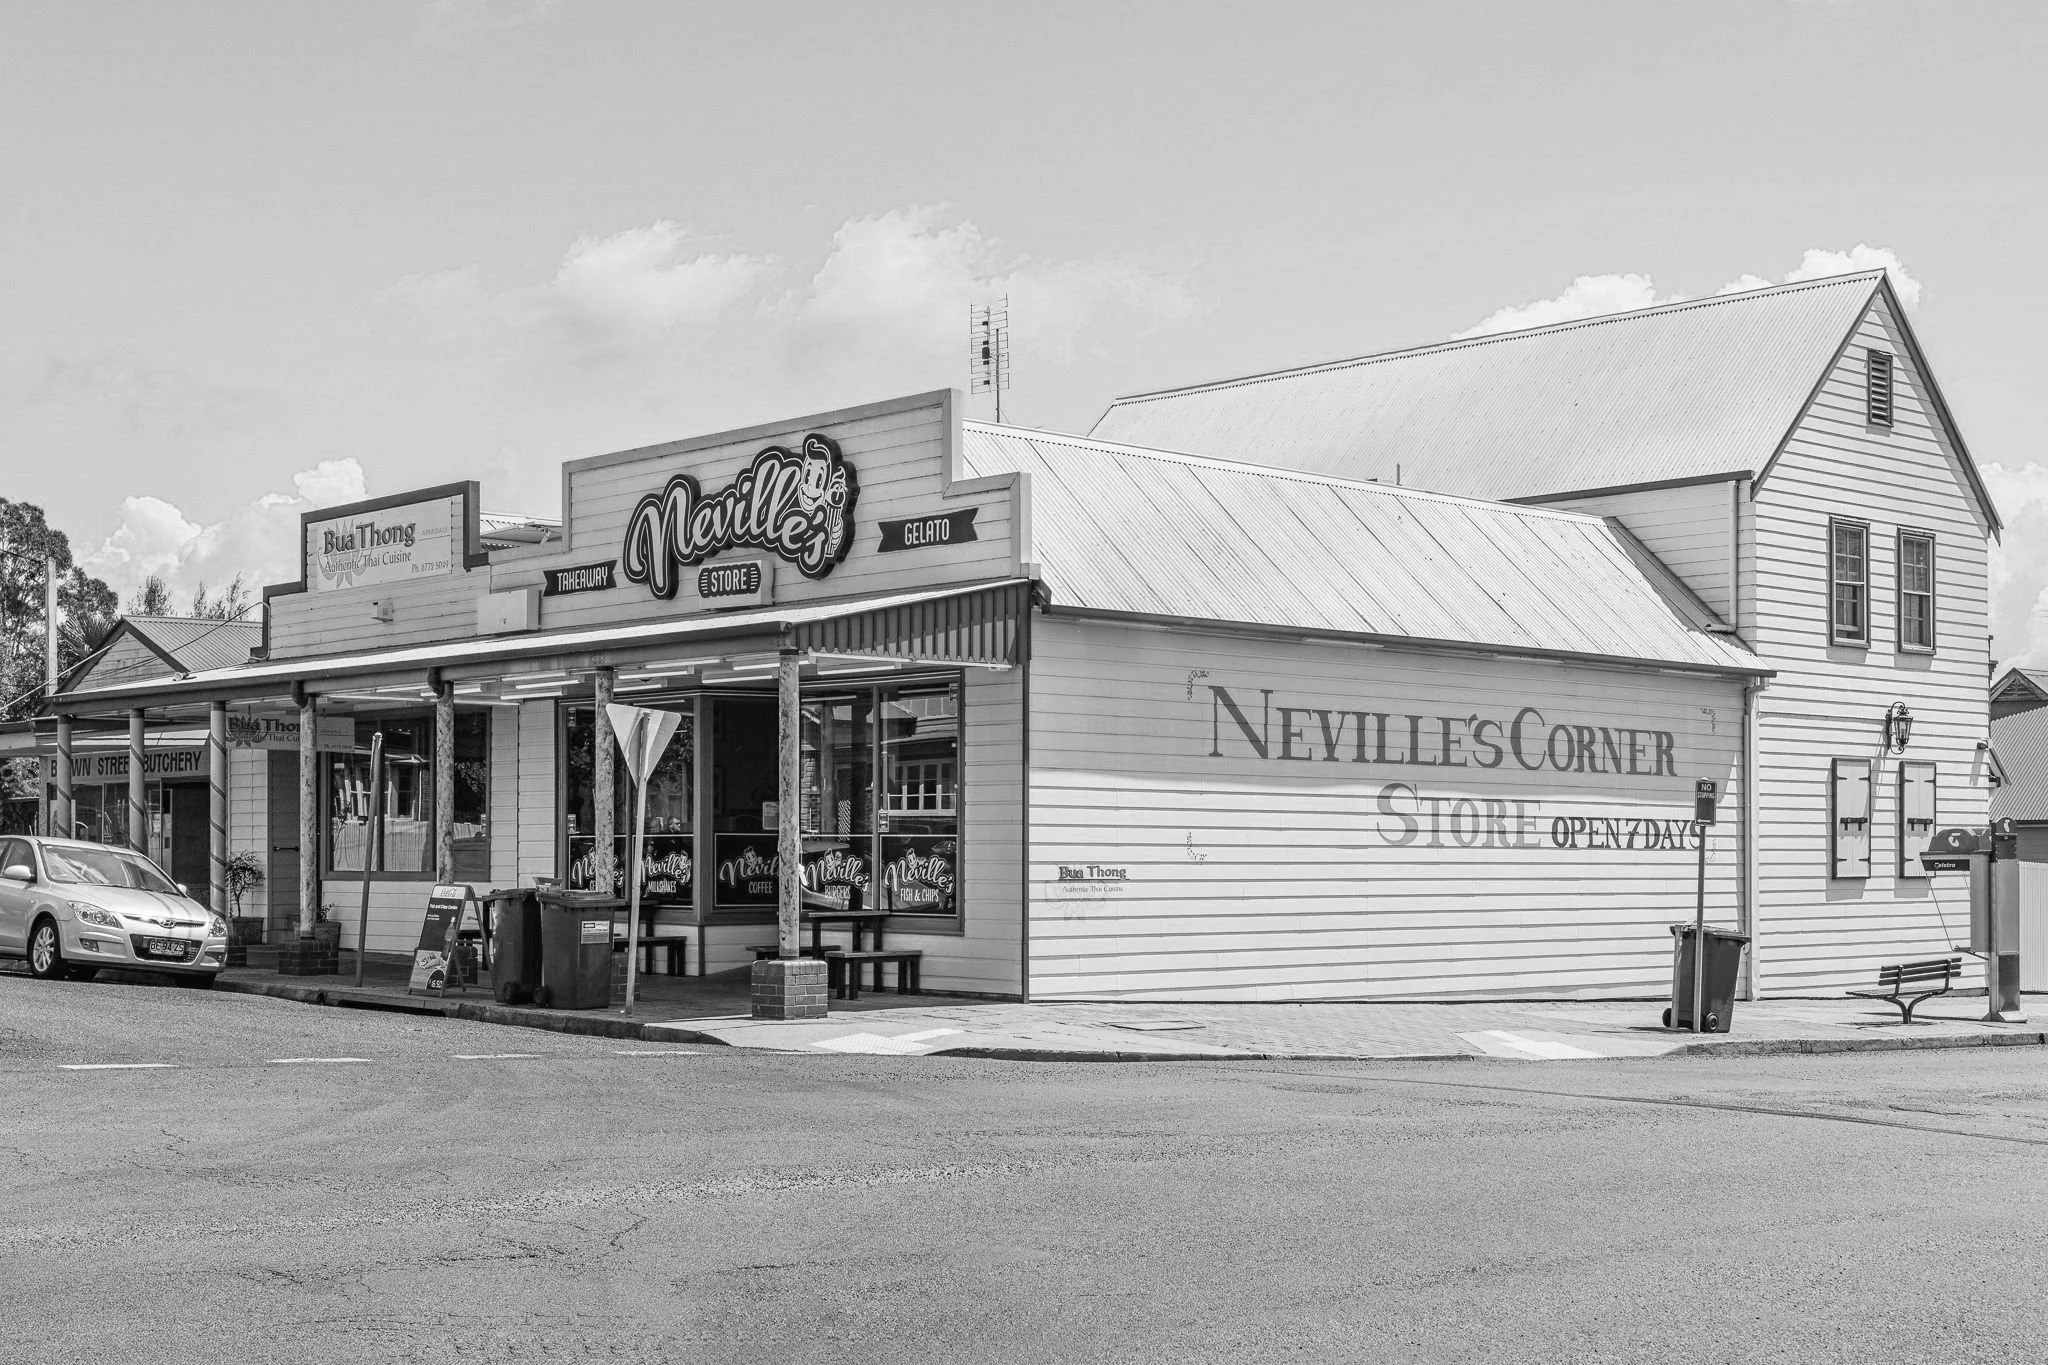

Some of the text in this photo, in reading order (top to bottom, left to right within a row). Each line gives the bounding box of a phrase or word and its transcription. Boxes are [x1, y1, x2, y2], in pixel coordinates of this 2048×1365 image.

[630, 456, 827, 590] Neville's
[905, 519, 949, 546] GELATO
[324, 521, 417, 554] Bua Thong
[325, 551, 412, 573] Authentic Thai Cuisine
[557, 566, 608, 592] TAKEAWAY
[711, 569, 747, 593] STORE
[1510, 707, 1678, 777] CORNER
[51, 758, 91, 778] BWN
[98, 755, 130, 776] STREE
[1701, 783, 1712, 791] NO
[1376, 782, 1541, 849] STORE
[1059, 866, 1127, 880] Bua Thong
[748, 881, 773, 894] COFFEE
[900, 888, 939, 903] FISH & CHIPS
